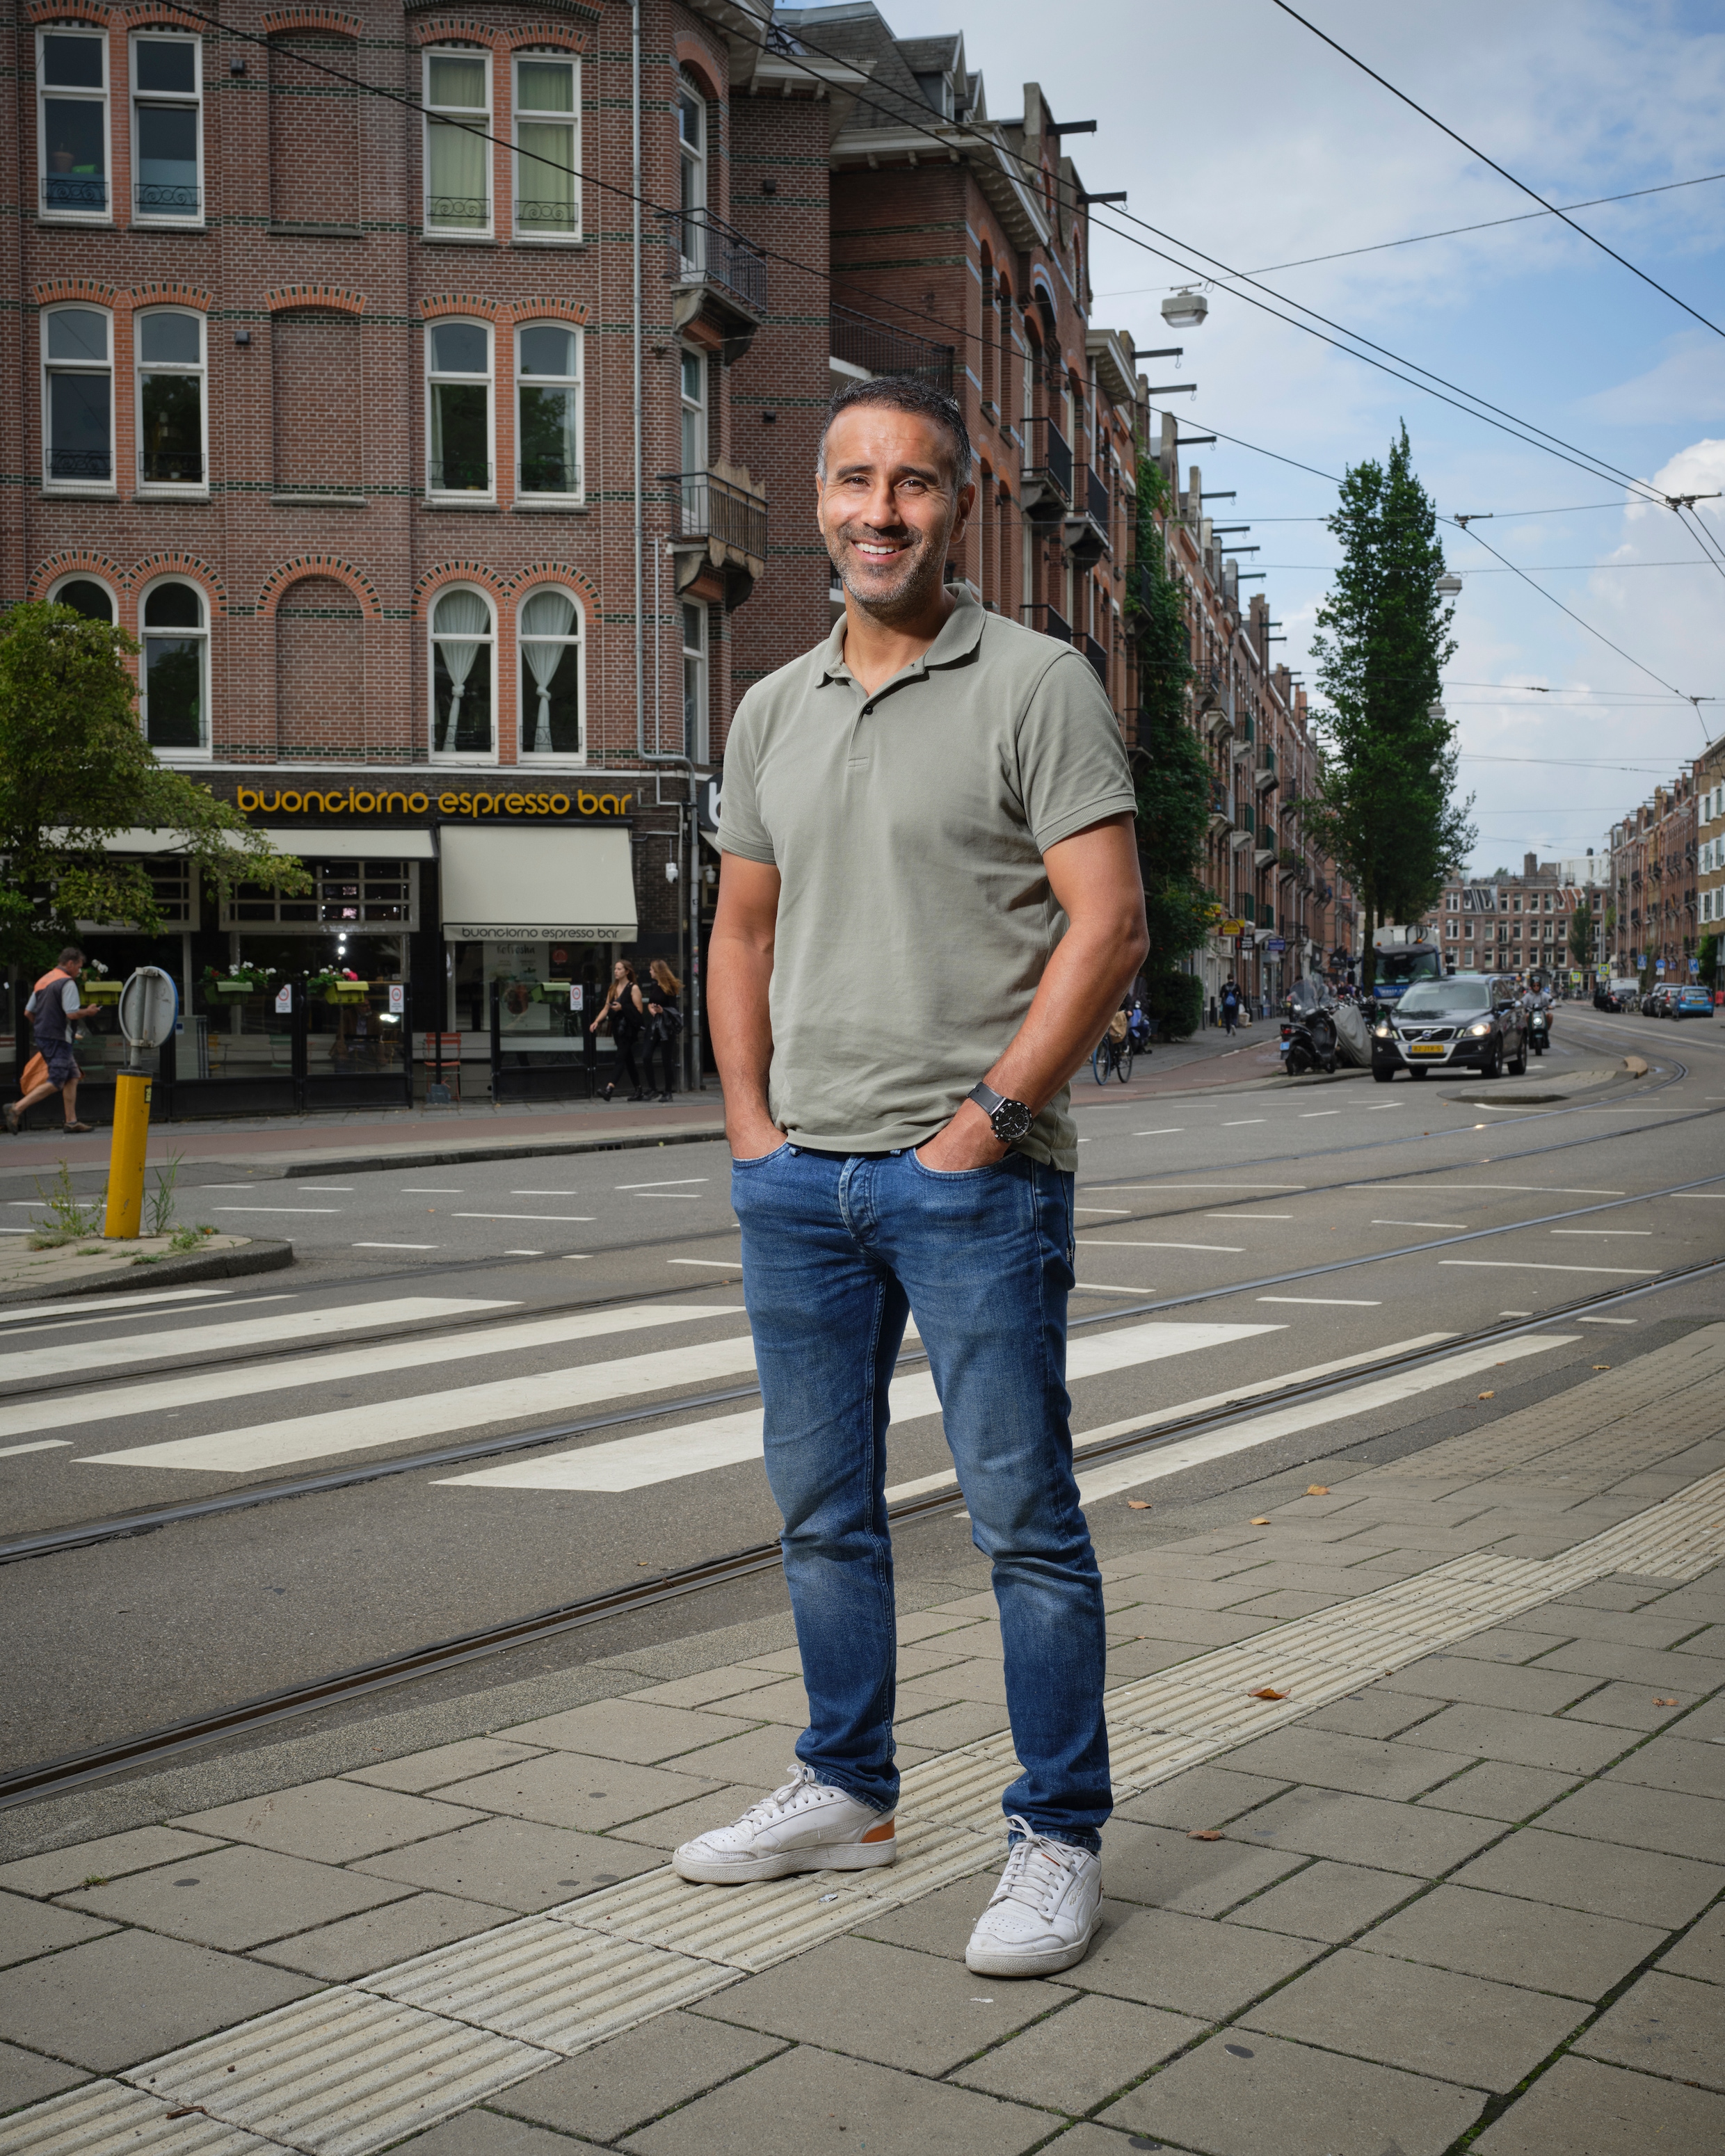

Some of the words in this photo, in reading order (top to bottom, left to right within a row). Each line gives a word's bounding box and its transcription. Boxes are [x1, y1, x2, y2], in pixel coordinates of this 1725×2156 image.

[438, 792, 570, 818] espresso
[577, 789, 632, 814] bar
[541, 928, 595, 939] espresso
[597, 928, 619, 939] bar
